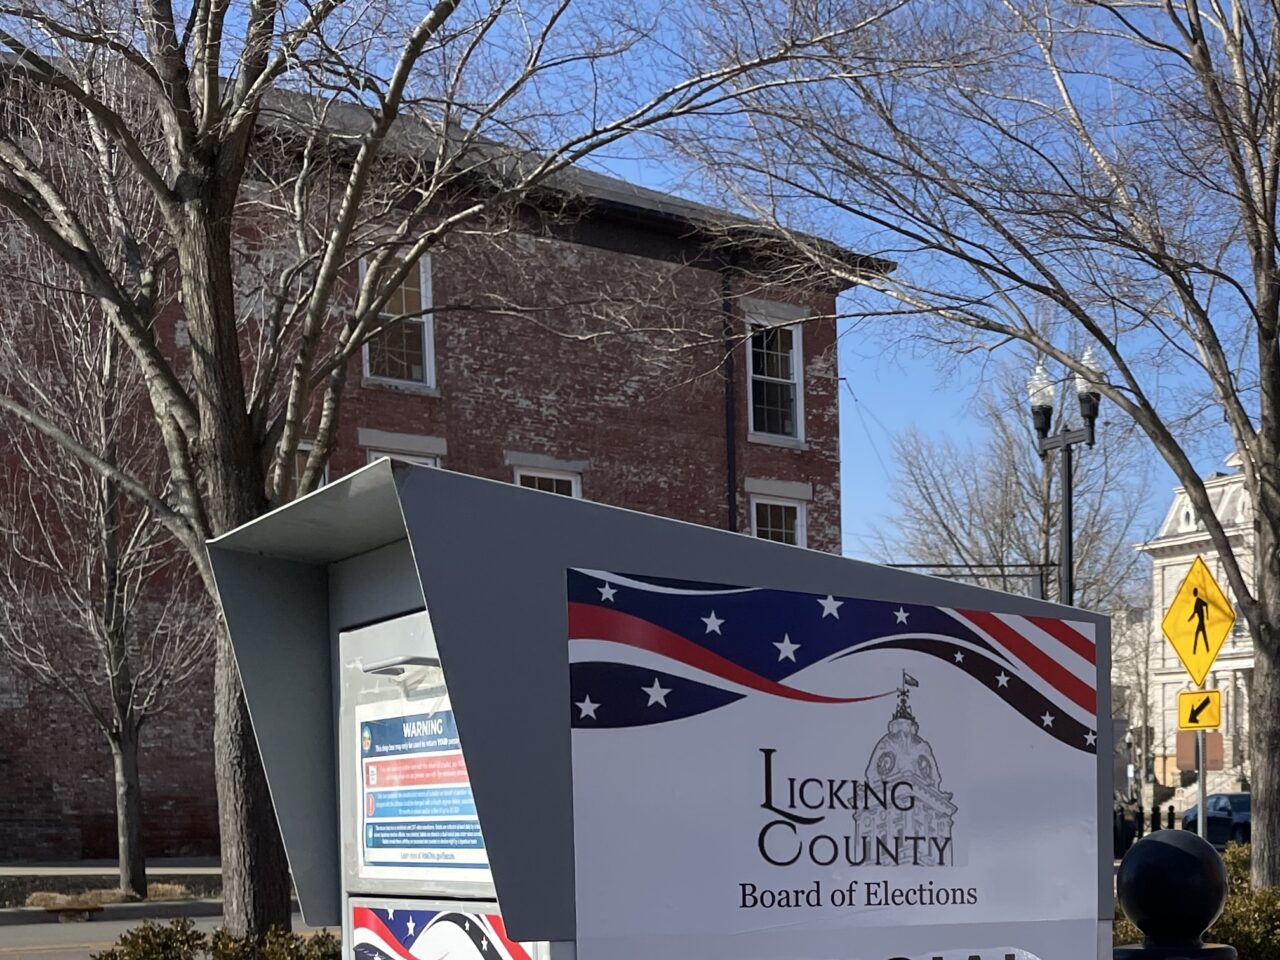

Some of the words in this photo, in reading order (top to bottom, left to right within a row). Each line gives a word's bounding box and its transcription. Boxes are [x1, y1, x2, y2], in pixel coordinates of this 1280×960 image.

[402, 718, 443, 738] WARNING
[738, 880, 823, 909] Board
[830, 880, 859, 908] of
[863, 880, 979, 907] Elections
